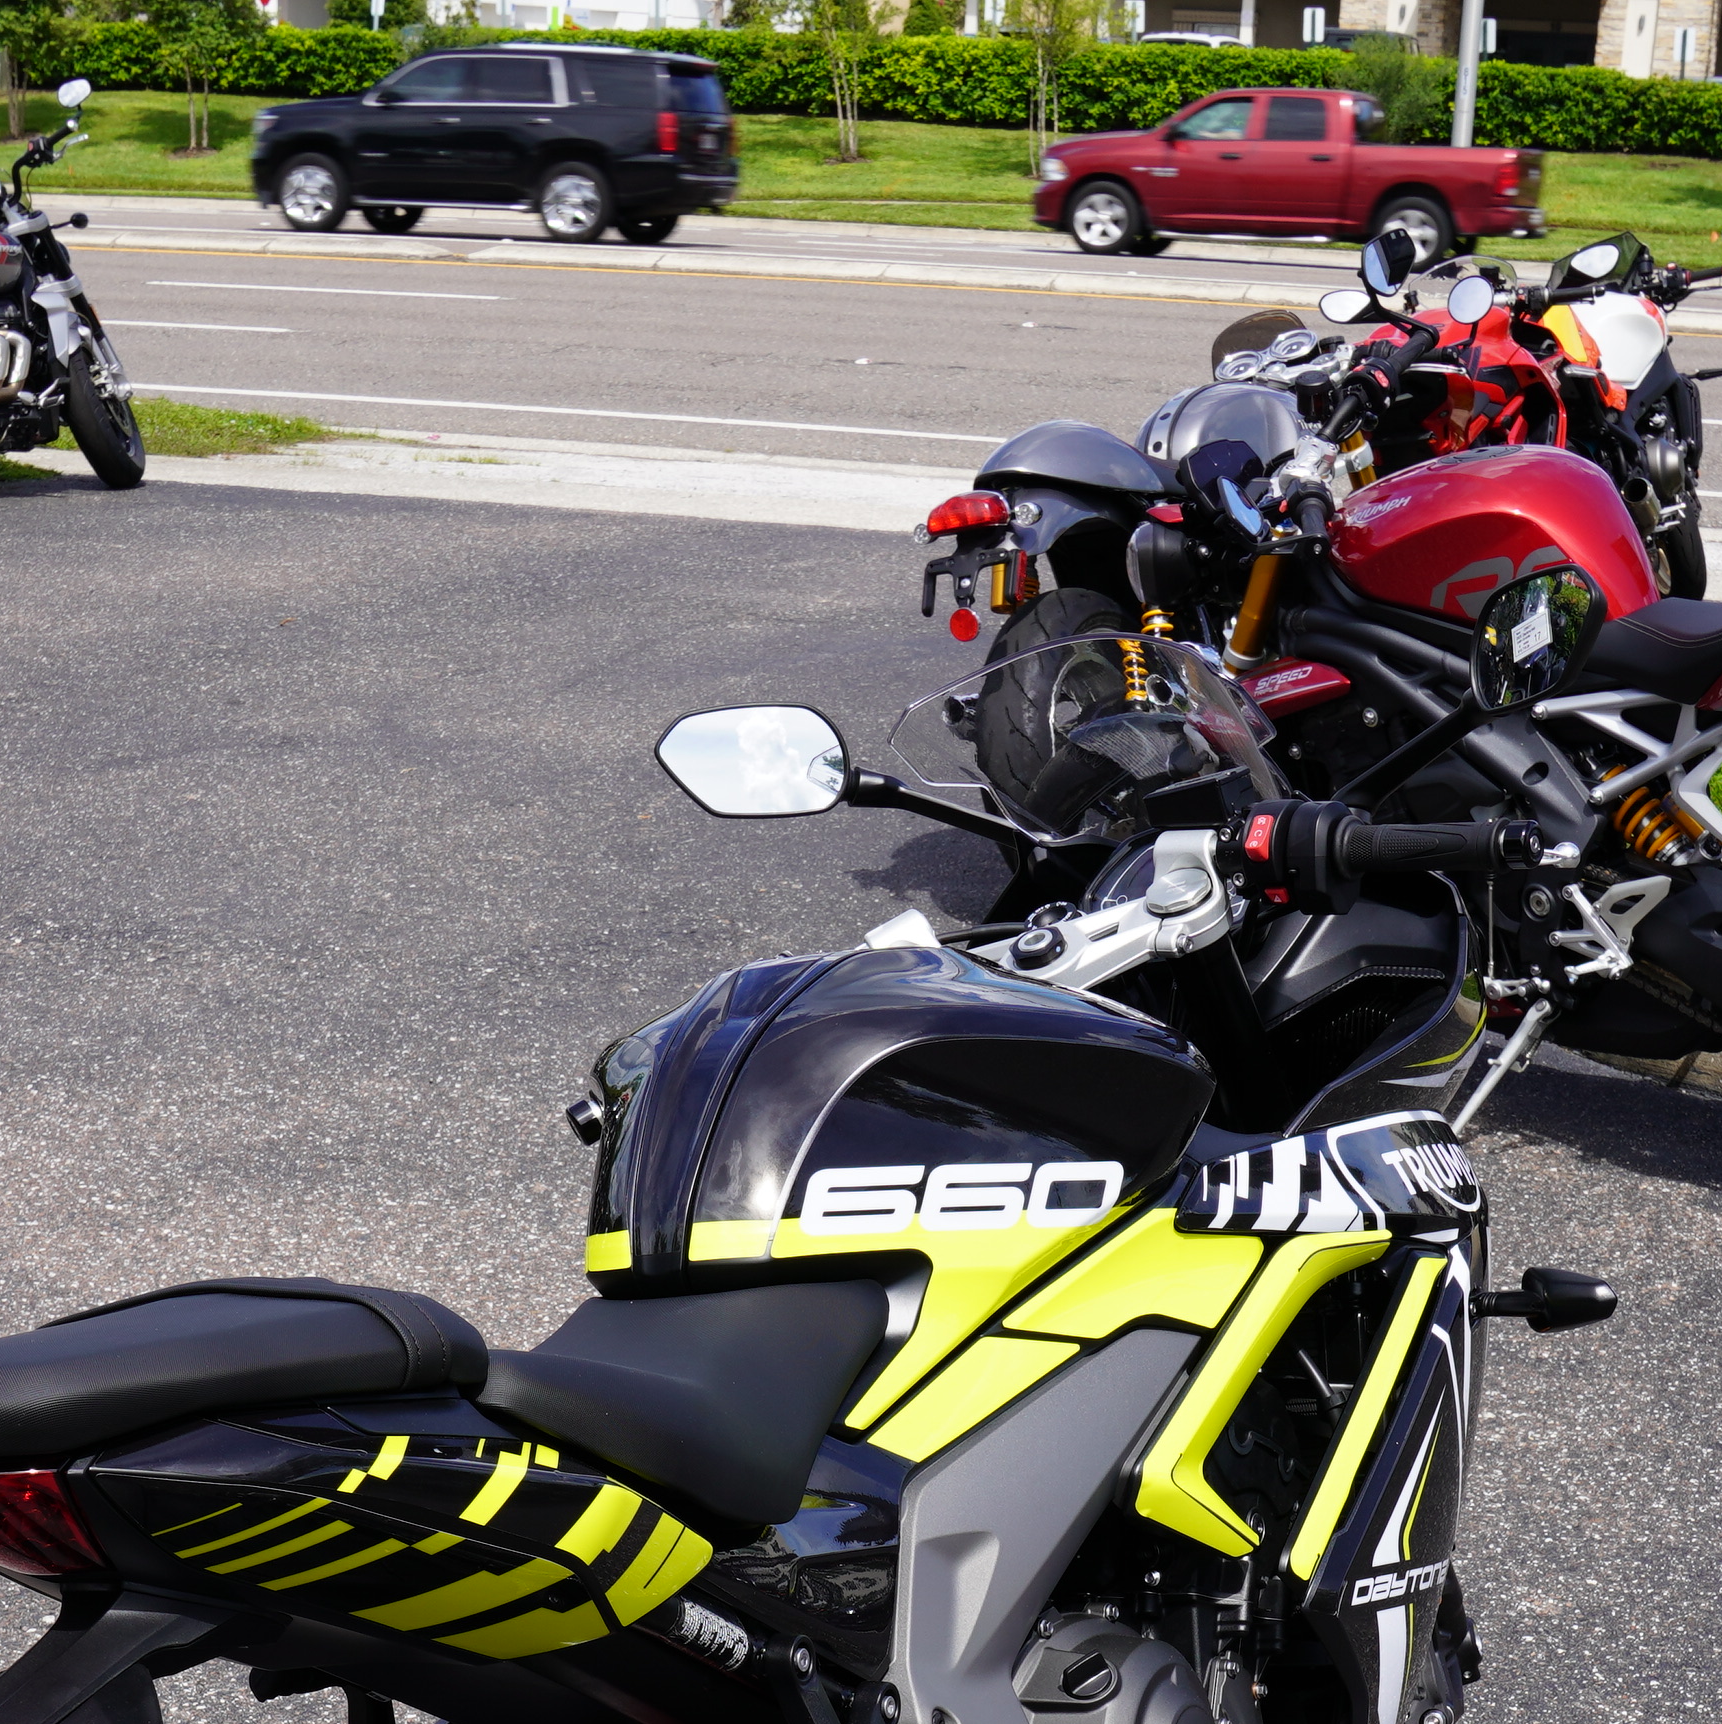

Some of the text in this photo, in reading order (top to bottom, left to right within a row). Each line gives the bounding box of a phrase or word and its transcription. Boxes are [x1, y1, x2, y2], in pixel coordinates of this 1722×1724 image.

[1253, 684, 1280, 697] TRIPLE
[1255, 666, 1313, 691] SPEED
[799, 1161, 1124, 1236] 660
